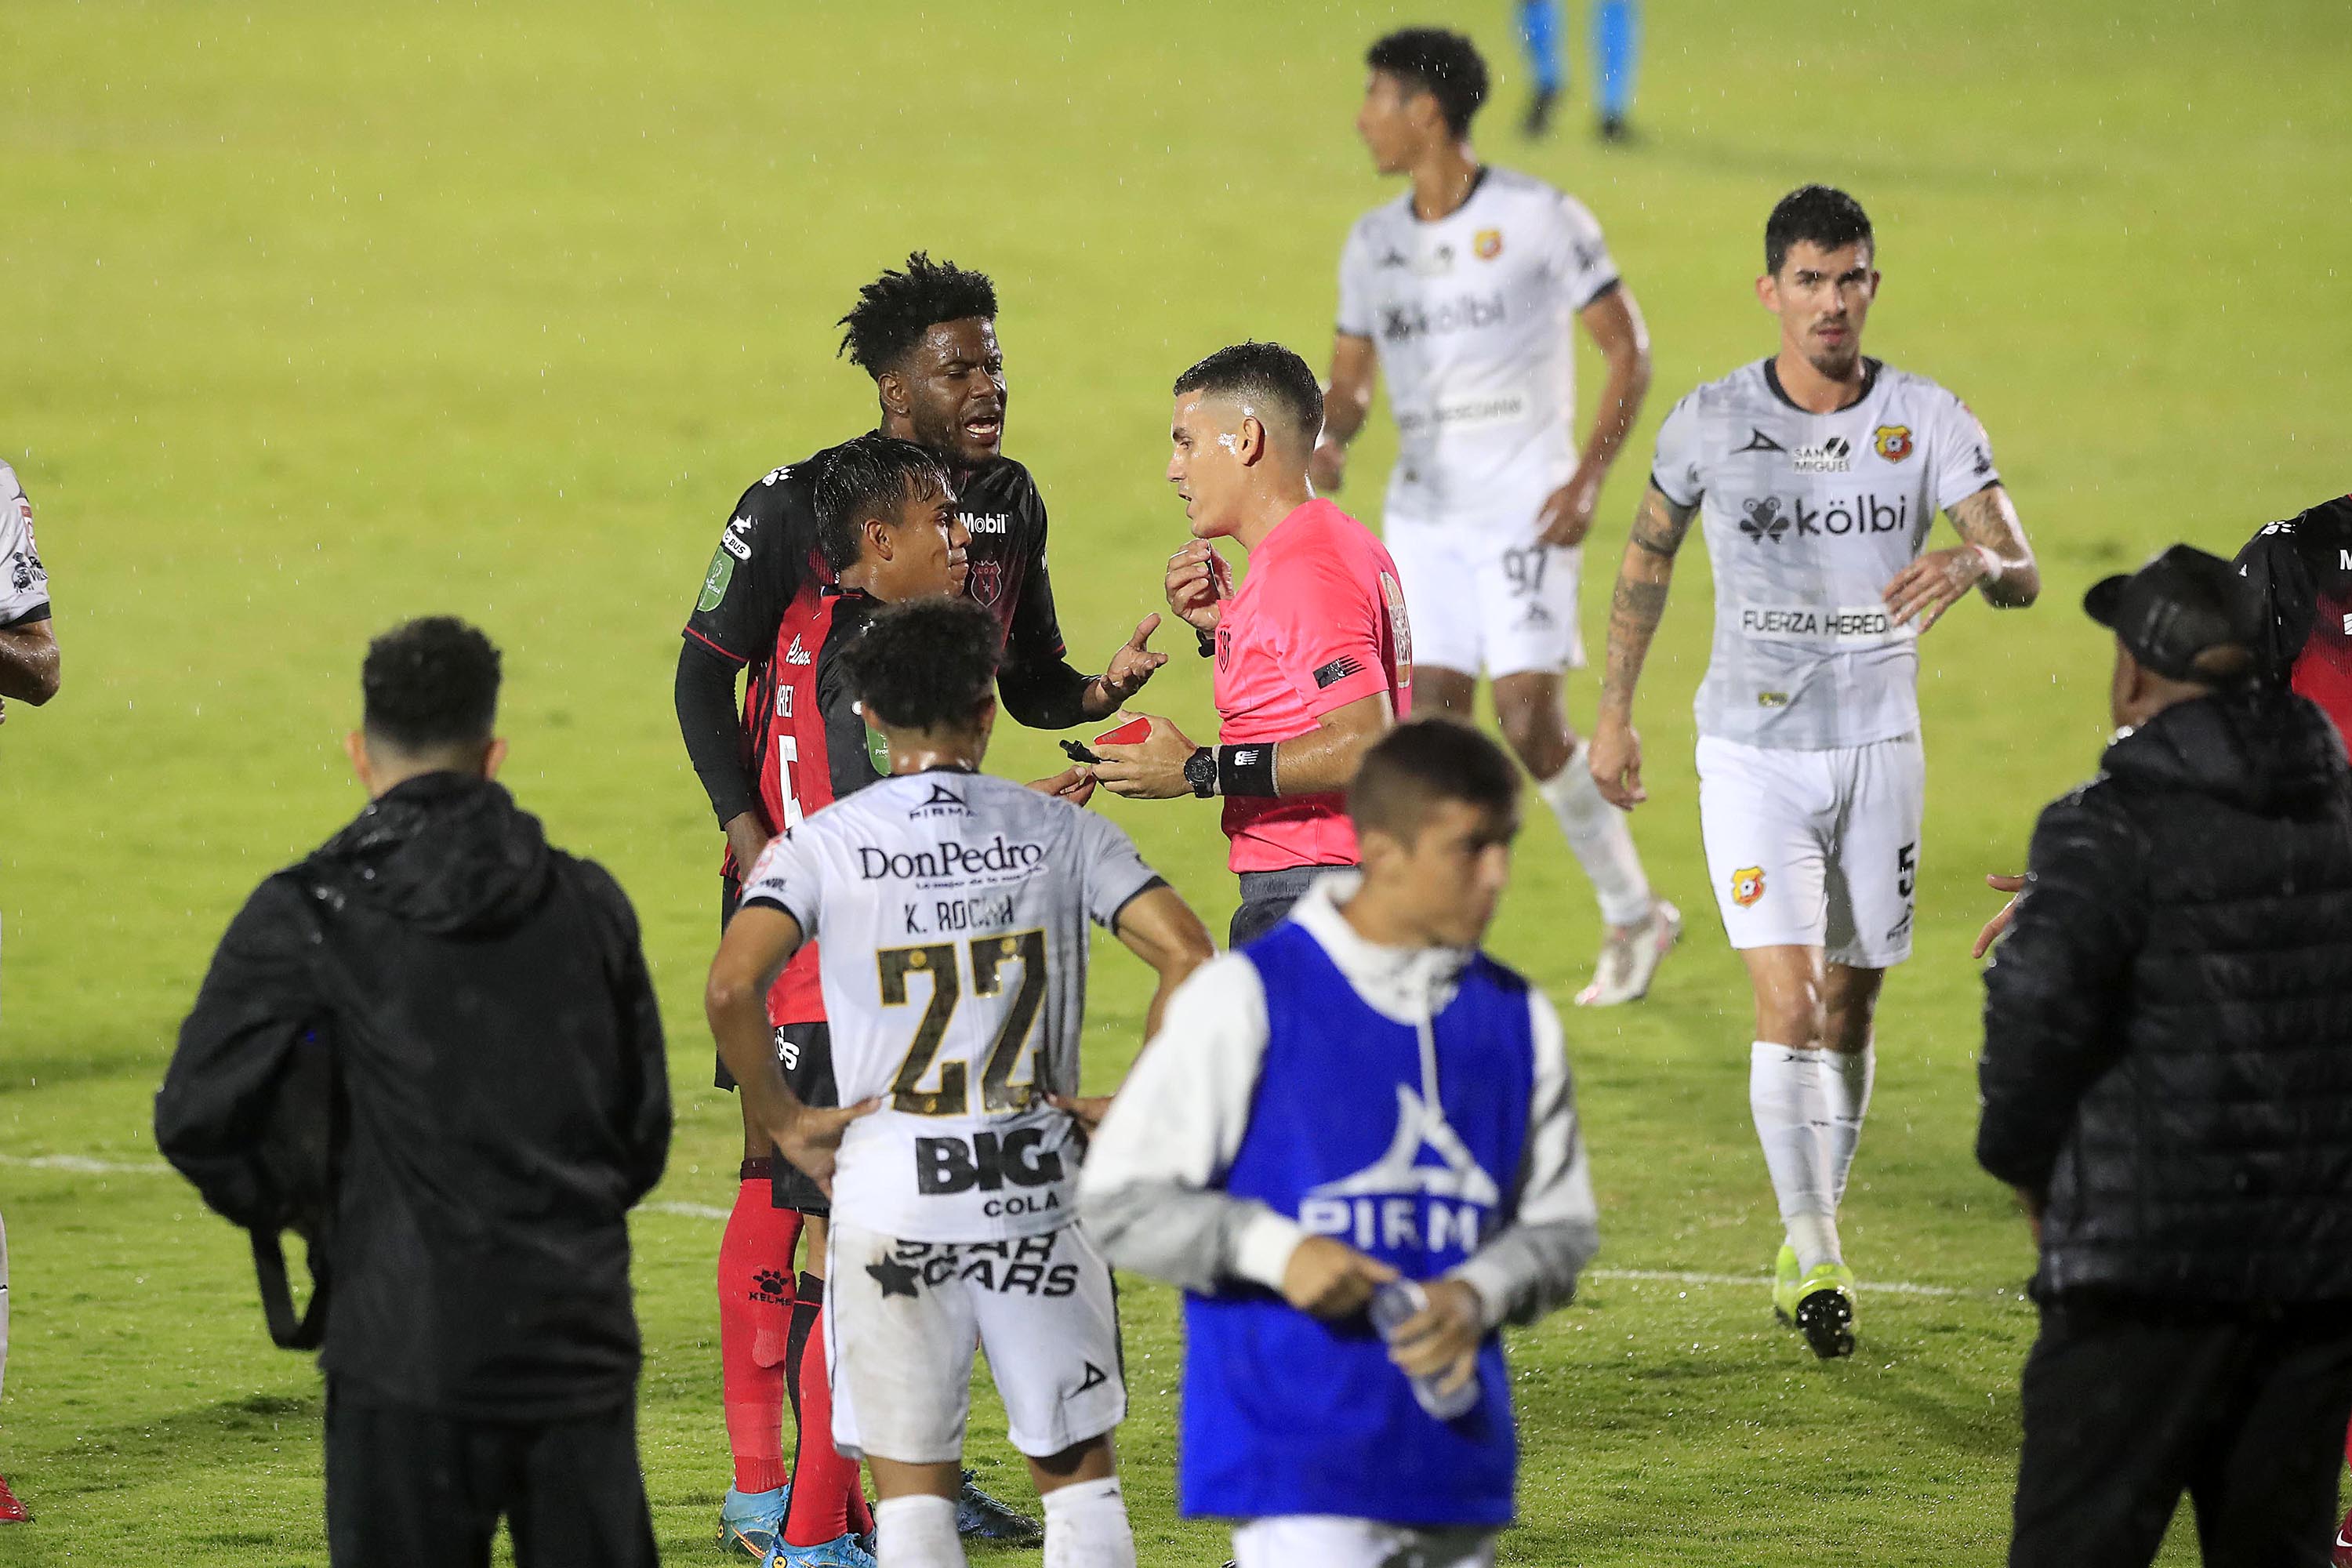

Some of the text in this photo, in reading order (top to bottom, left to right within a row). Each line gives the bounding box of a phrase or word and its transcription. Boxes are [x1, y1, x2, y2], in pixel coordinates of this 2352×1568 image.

[958, 512, 1007, 534] Mobil
[1795, 493, 1907, 537] kölbi
[728, 538, 746, 554] BUS
[1502, 545, 1548, 597] 97
[1743, 609, 1889, 636] FUERZA HERED
[1897, 841, 1915, 898] 5
[905, 903, 928, 934] K.
[874, 927, 1048, 1118] 22
[915, 1127, 1065, 1196] BIG
[983, 1190, 1060, 1217] COLA
[1298, 1198, 1480, 1253] PIRM
[922, 1254, 1079, 1298] CARS
[748, 1291, 791, 1306] KELME
